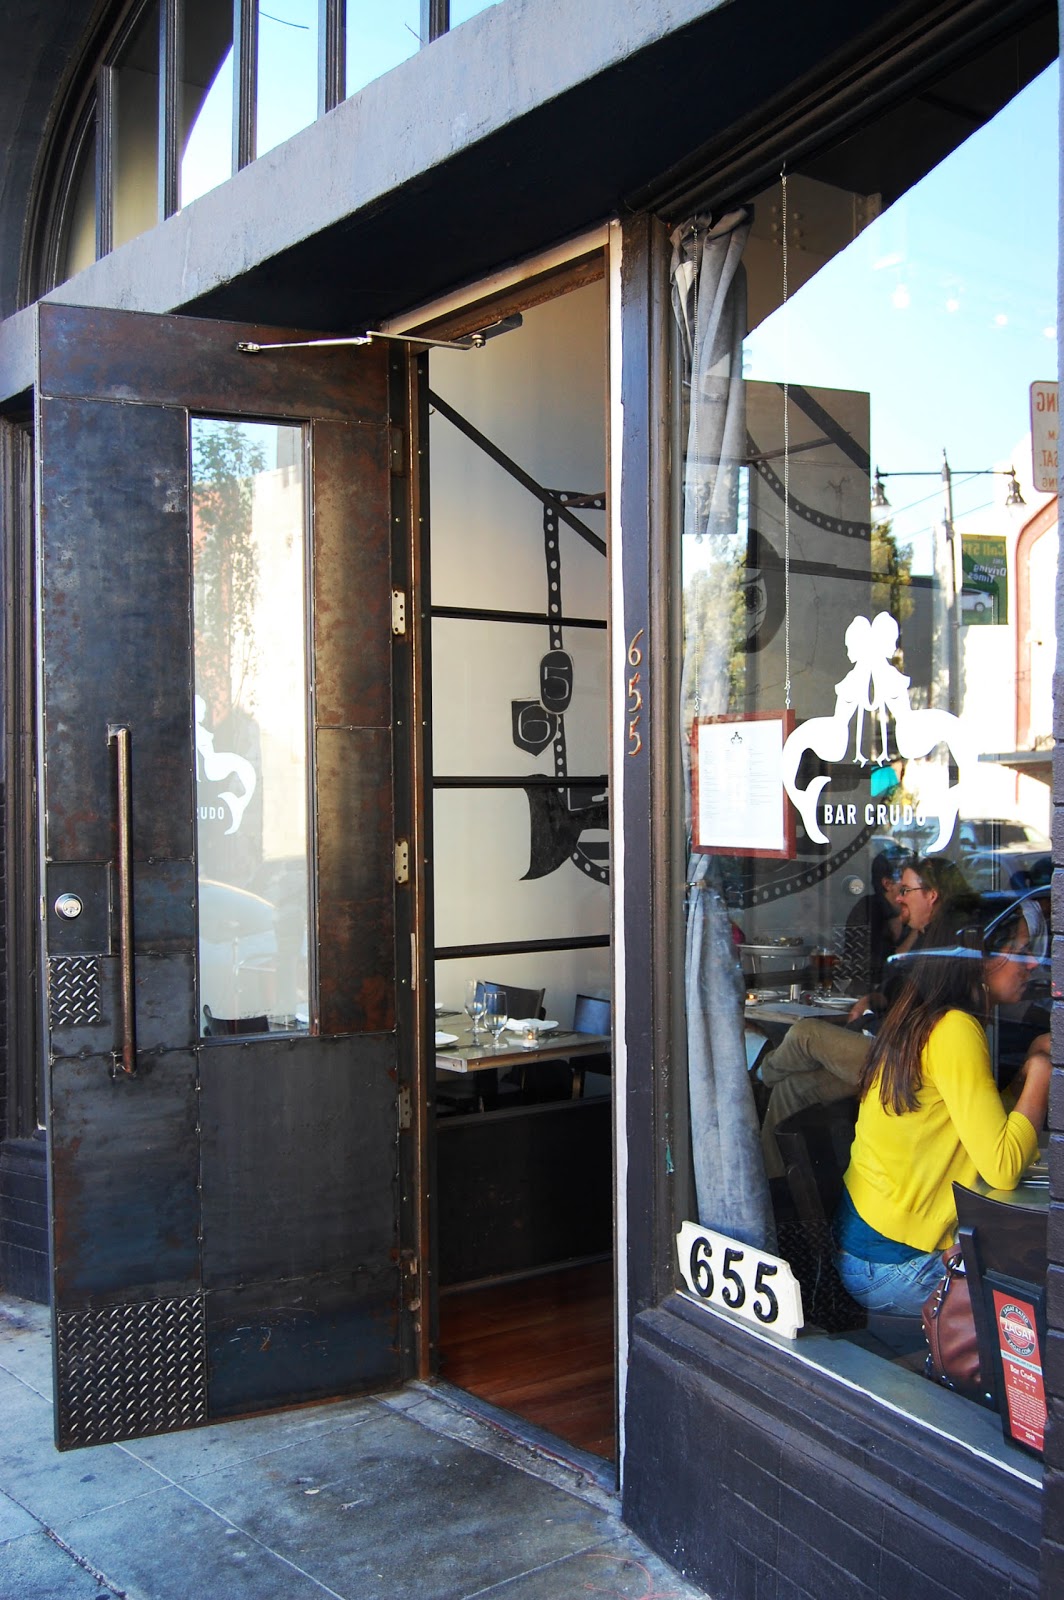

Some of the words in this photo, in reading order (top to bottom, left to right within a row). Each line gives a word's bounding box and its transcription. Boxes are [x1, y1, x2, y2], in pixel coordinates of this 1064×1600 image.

[628, 629, 643, 756] 655
[197, 806, 225, 820] UDO
[824, 804, 857, 824] BAR
[865, 803, 926, 826] CRUDO
[690, 1236, 779, 1324] 655
[1004, 1321, 1032, 1341] ZAGAT
